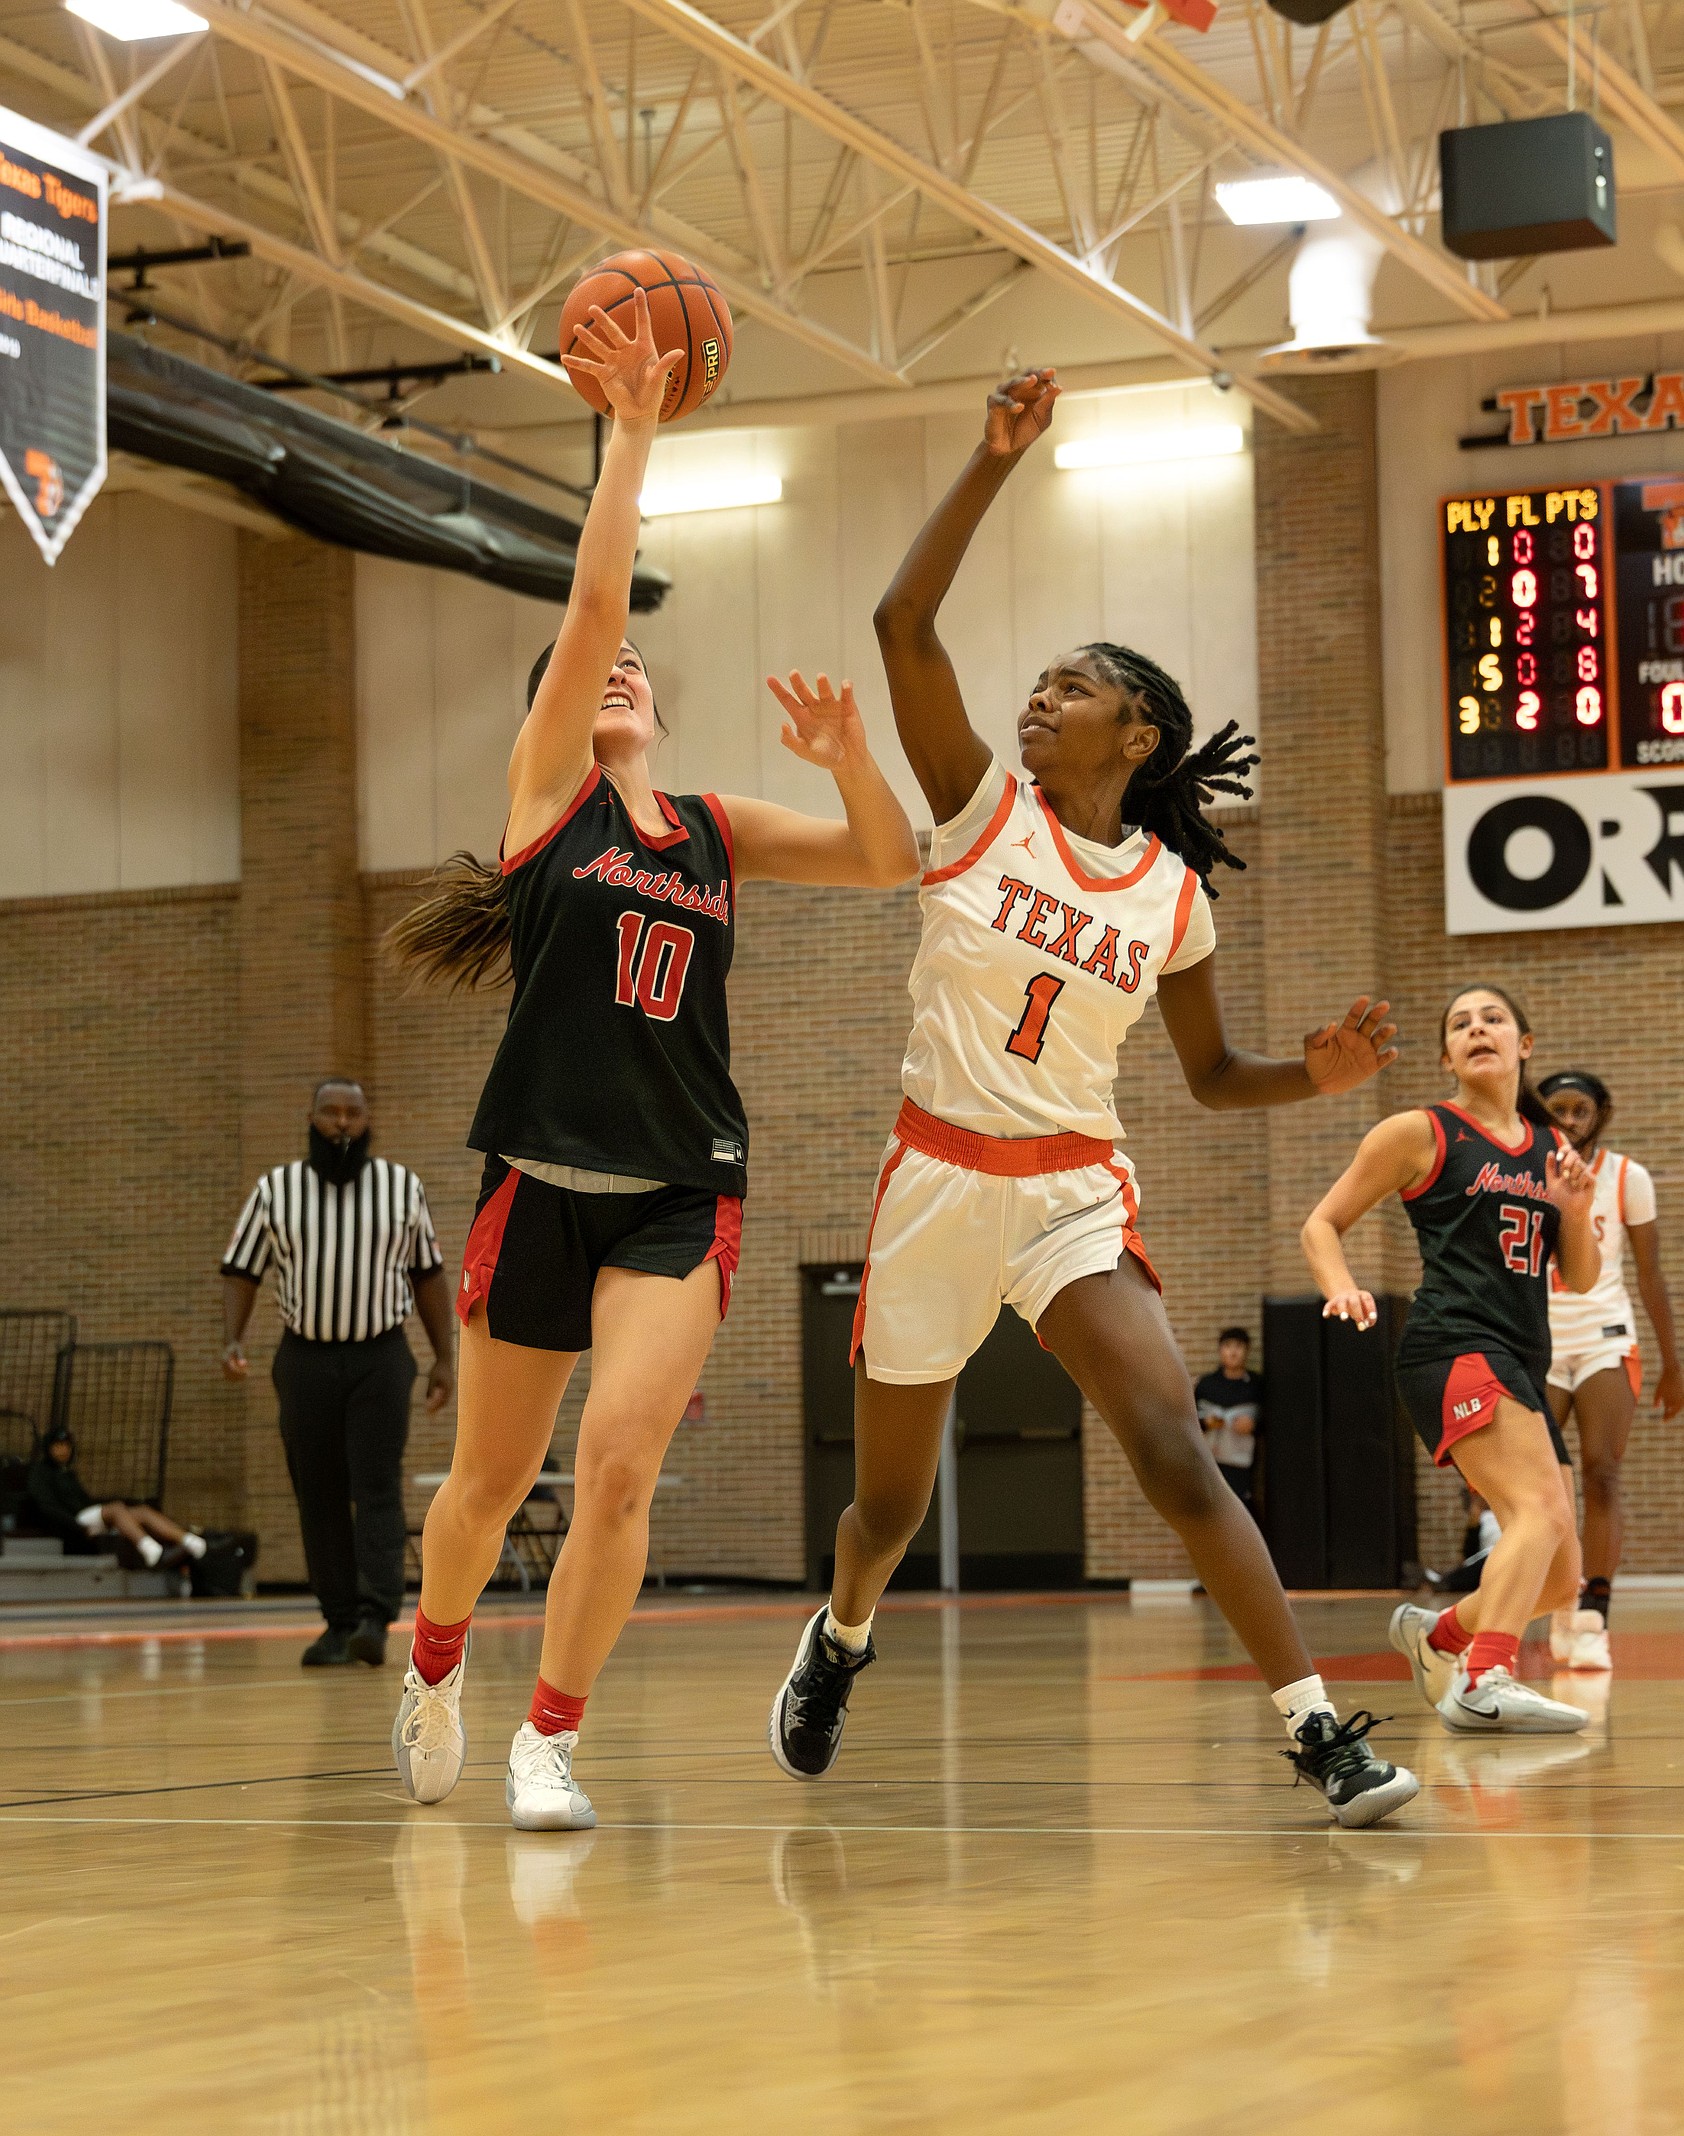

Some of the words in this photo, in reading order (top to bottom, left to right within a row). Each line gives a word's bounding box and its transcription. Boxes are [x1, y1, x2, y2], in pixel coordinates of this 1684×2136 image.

[42, 172, 98, 224] Tigers
[1, 211, 85, 271] REGIONAL
[705, 341, 719, 379] PRO
[1497, 373, 1684, 445] TEXA
[1447, 499, 1495, 534] PLY
[1507, 495, 1541, 528] FL
[1546, 488, 1598, 524] PTS
[1576, 607, 1598, 638] 4
[1515, 690, 1541, 730] 2
[991, 874, 1150, 994] TEXAS
[615, 910, 695, 1022] 10
[1004, 971, 1066, 1065] 1
[1499, 1203, 1545, 1277] 21
[1453, 1397, 1482, 1420] NLB
